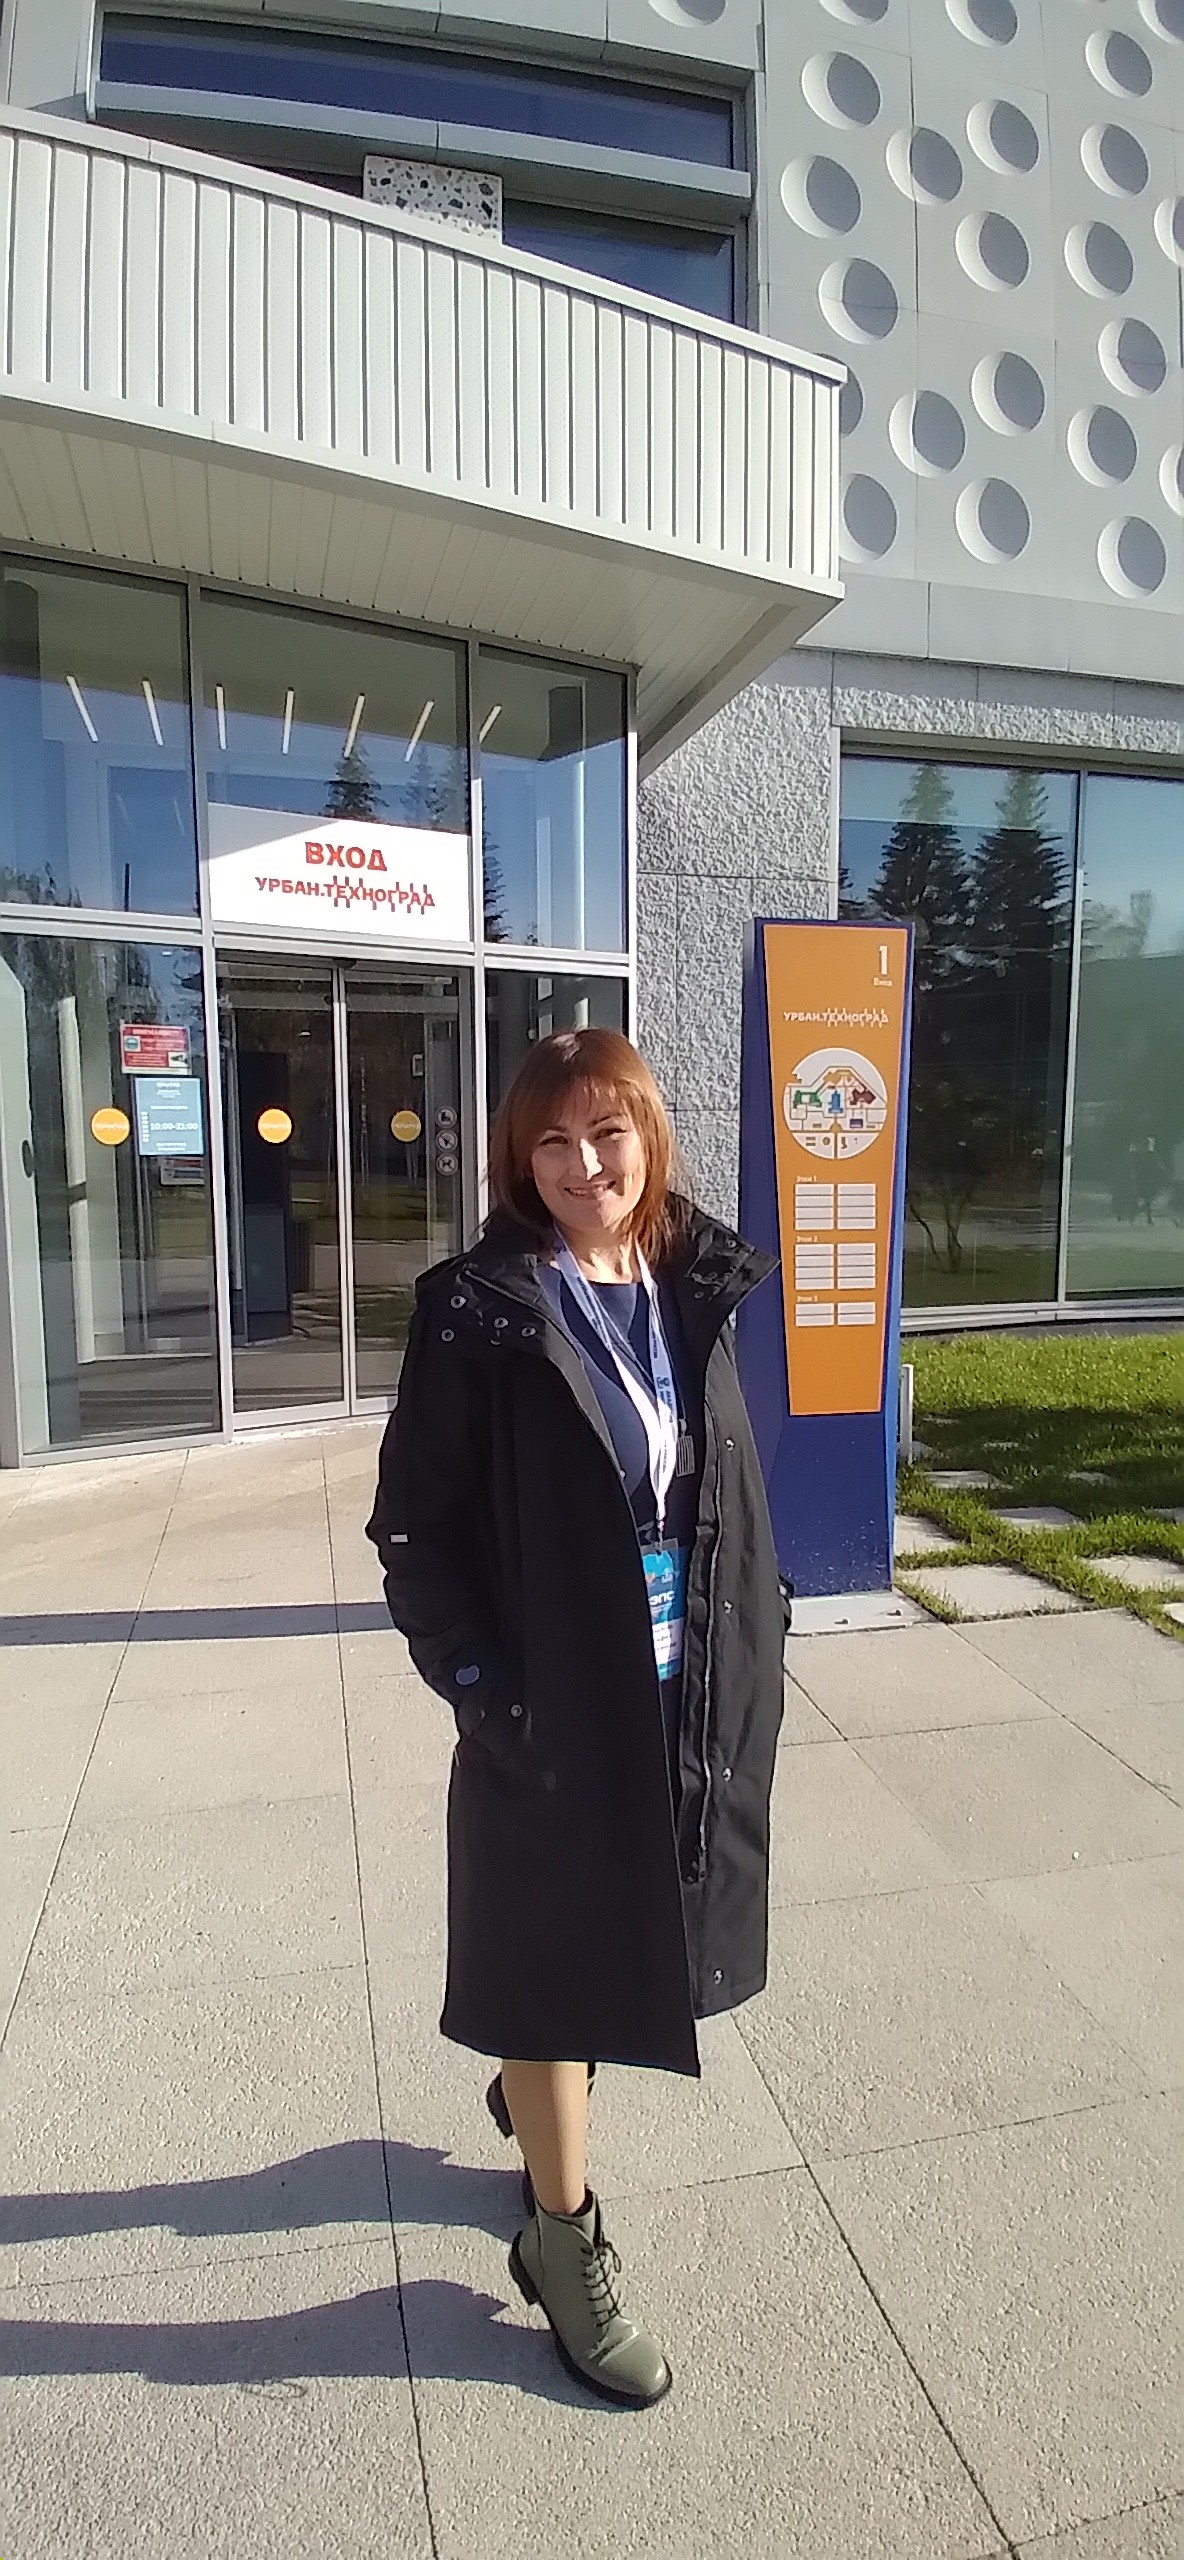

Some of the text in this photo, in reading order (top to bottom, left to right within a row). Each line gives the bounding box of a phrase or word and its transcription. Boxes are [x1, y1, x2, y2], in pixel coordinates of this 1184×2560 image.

[304, 841, 388, 872] ВХОД
[255, 875, 436, 915] УРБАН.ТЕХНОГРАД
[879, 945, 888, 975] 1
[783, 1007, 889, 1028] УРБАН.ТЕХНОГРАД
